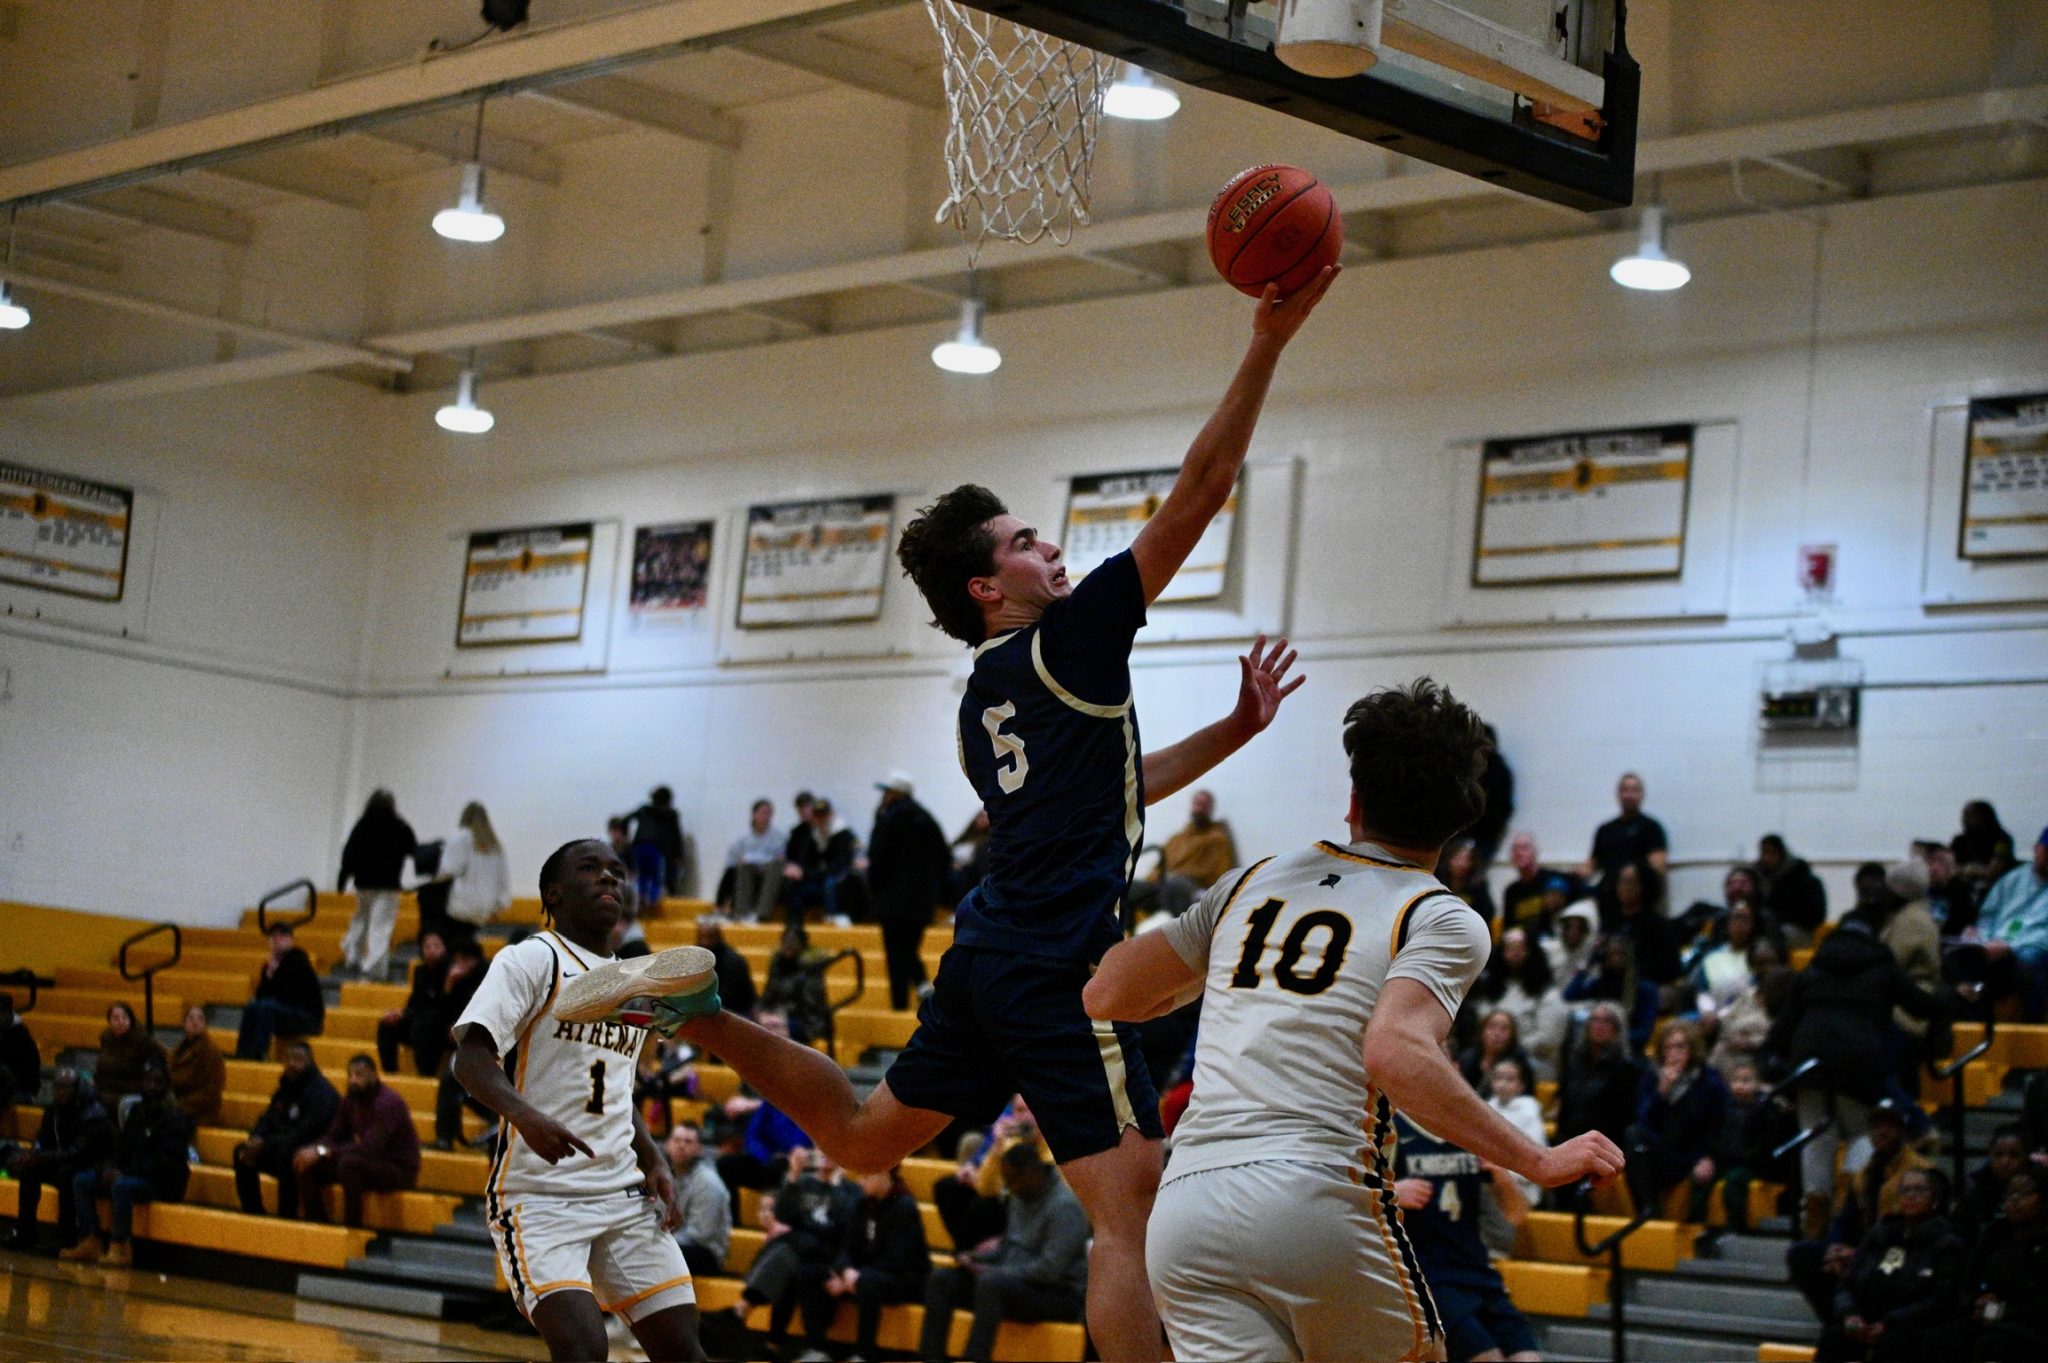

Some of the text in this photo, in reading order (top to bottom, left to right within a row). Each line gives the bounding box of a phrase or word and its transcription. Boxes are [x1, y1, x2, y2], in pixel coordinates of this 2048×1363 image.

[982, 700, 1029, 794] 5
[1230, 896, 1355, 995] 10
[584, 1058, 608, 1116] 1
[1439, 1181, 1463, 1222] 4
